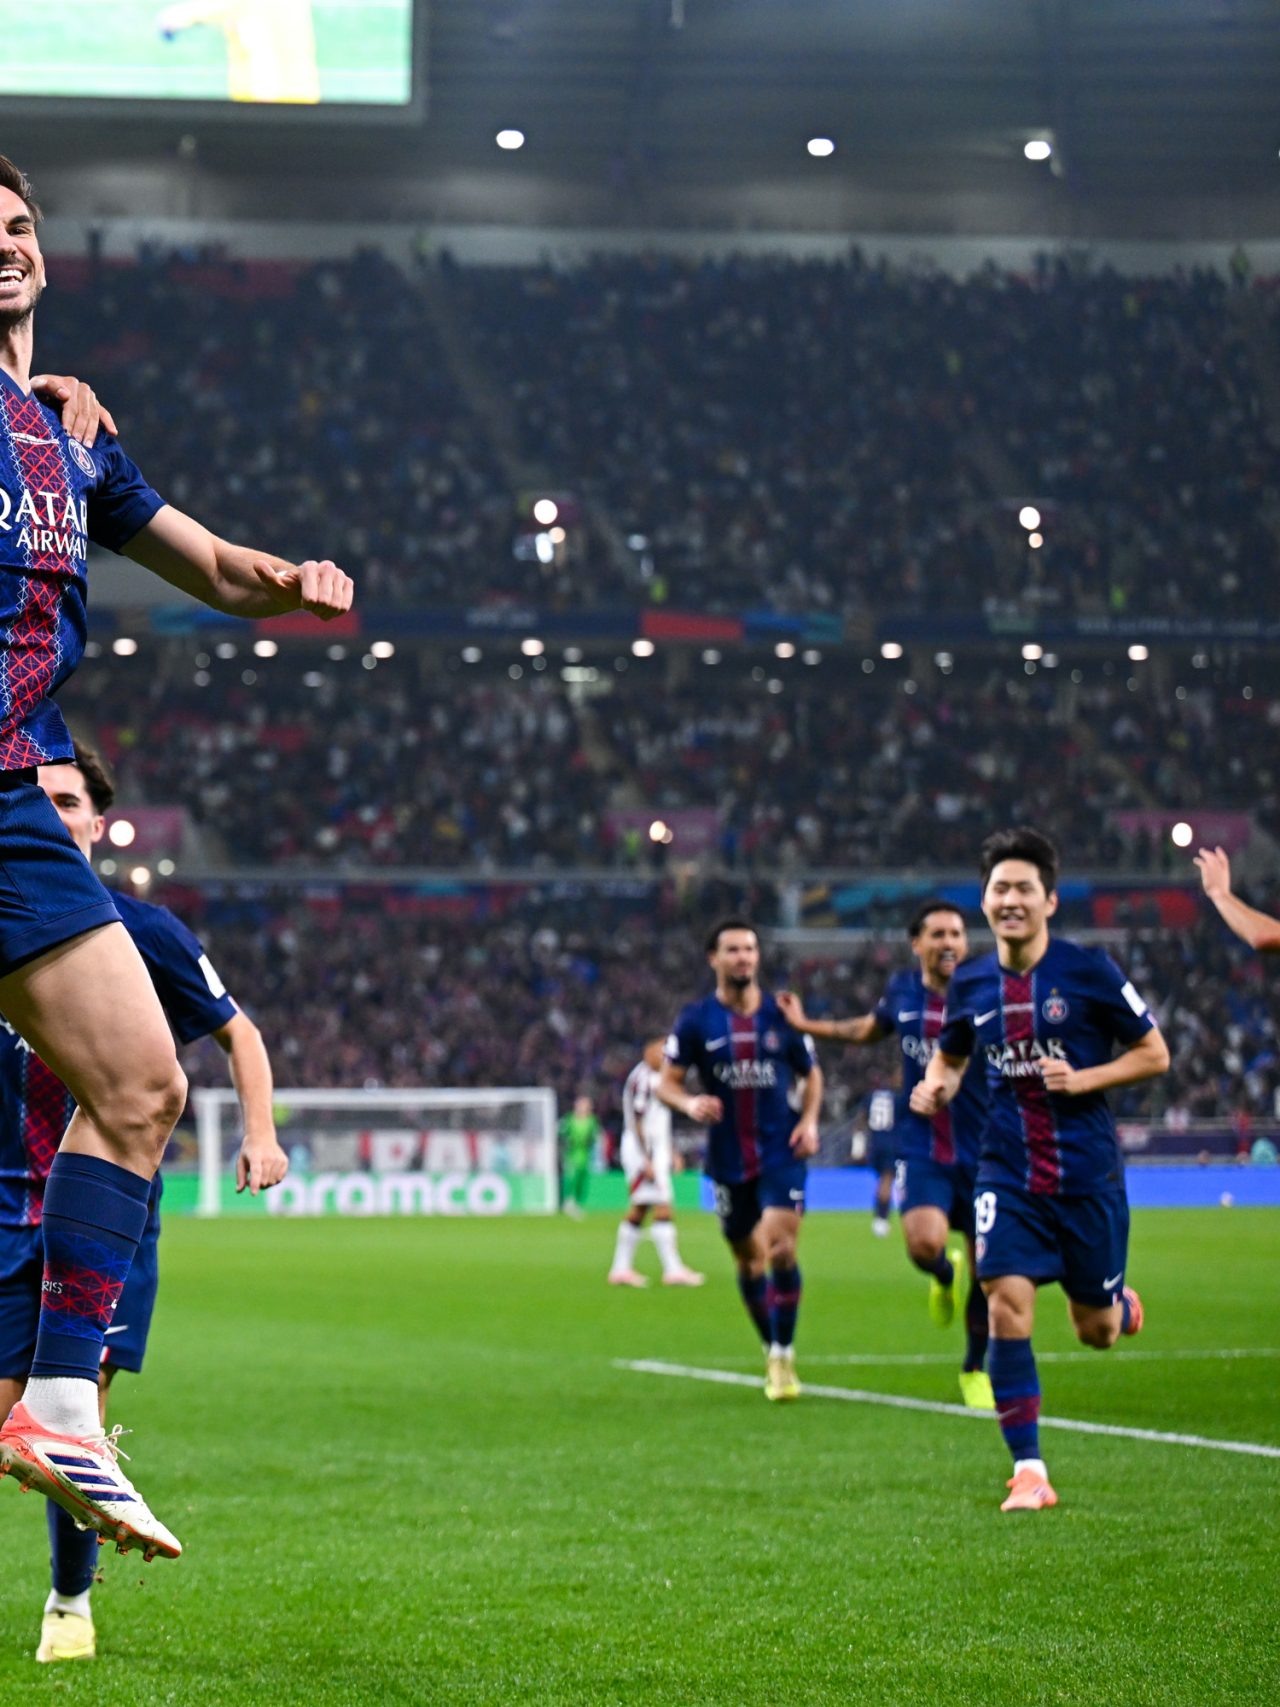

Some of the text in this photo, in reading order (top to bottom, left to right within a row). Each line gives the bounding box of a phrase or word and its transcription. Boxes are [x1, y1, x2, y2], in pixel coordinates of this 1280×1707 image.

[15, 527, 88, 560] AIRWAY
[266, 1172, 511, 1217] aramco
[41, 1280, 63, 1294] RIS
